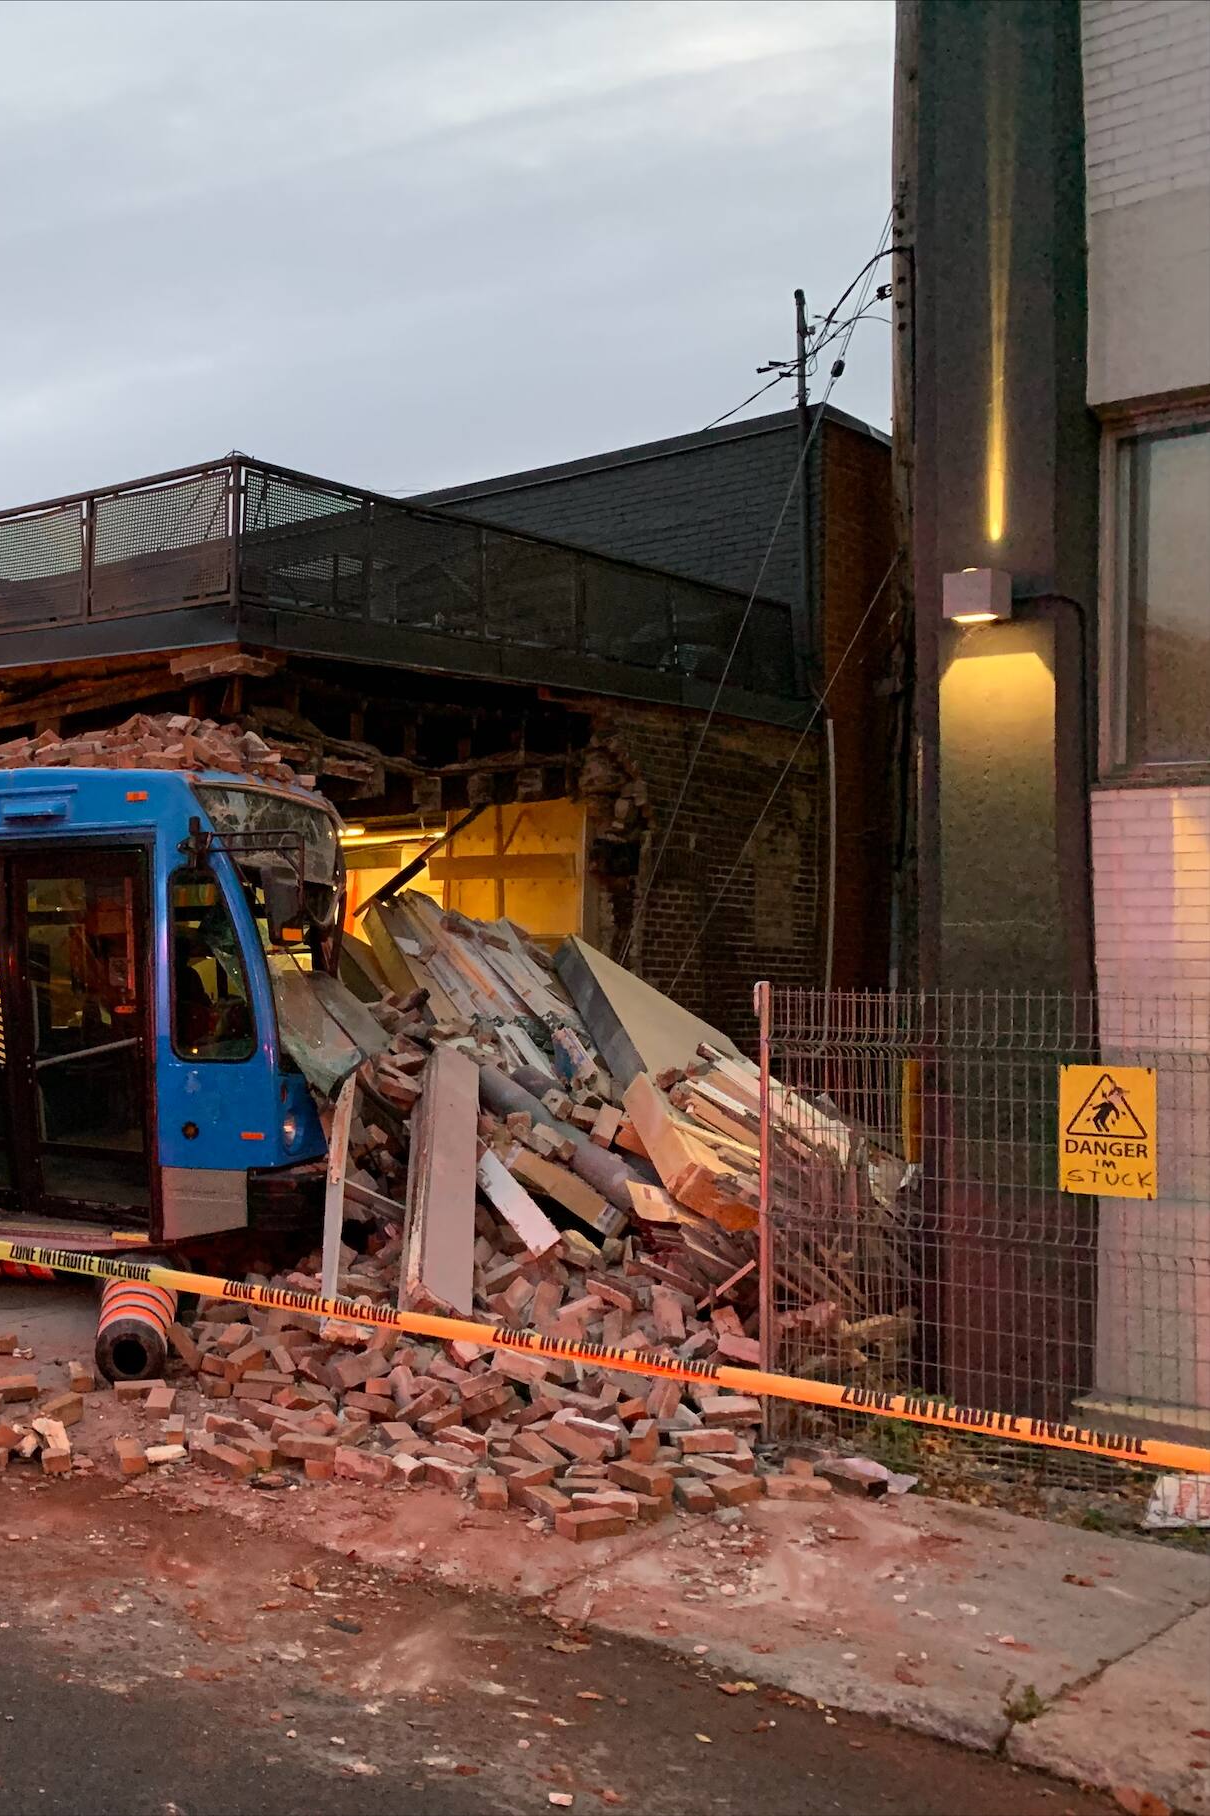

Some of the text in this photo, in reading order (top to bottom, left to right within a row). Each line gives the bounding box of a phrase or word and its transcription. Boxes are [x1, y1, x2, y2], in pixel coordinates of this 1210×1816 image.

[1065, 1139, 1148, 1158] DANGER
[1066, 1169, 1152, 1188] STUCK
[222, 1281, 256, 1301] ZONE
